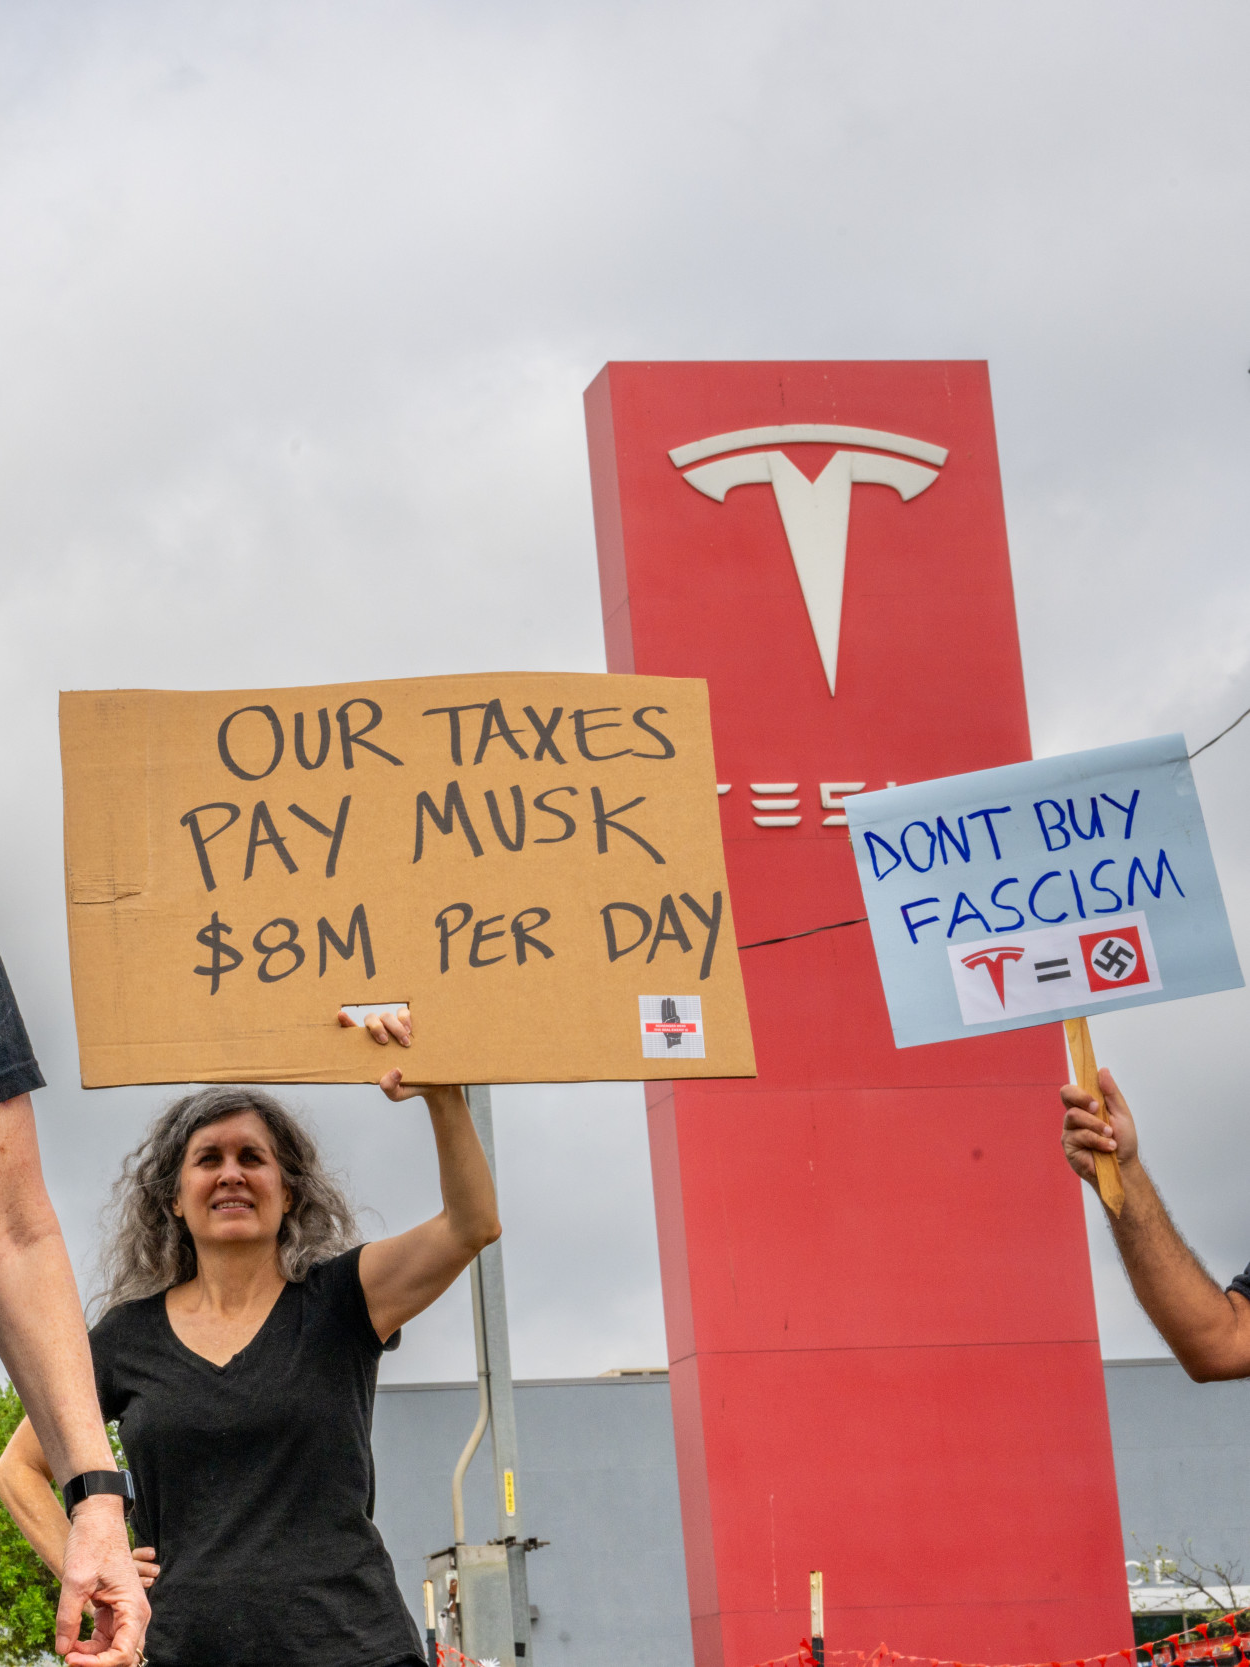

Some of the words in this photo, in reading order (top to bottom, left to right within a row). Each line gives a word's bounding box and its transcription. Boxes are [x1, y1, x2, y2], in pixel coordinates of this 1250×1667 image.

[217, 698, 404, 781] OUR
[422, 698, 676, 766] TAXES
[180, 795, 352, 892] PAY
[412, 780, 666, 864] MUSK
[863, 806, 1012, 881] DONT
[1033, 789, 1140, 852] BUY
[193, 903, 376, 995] $8M
[435, 902, 555, 974] PER
[600, 890, 723, 980] DAY
[900, 848, 1186, 944] FASCISM
